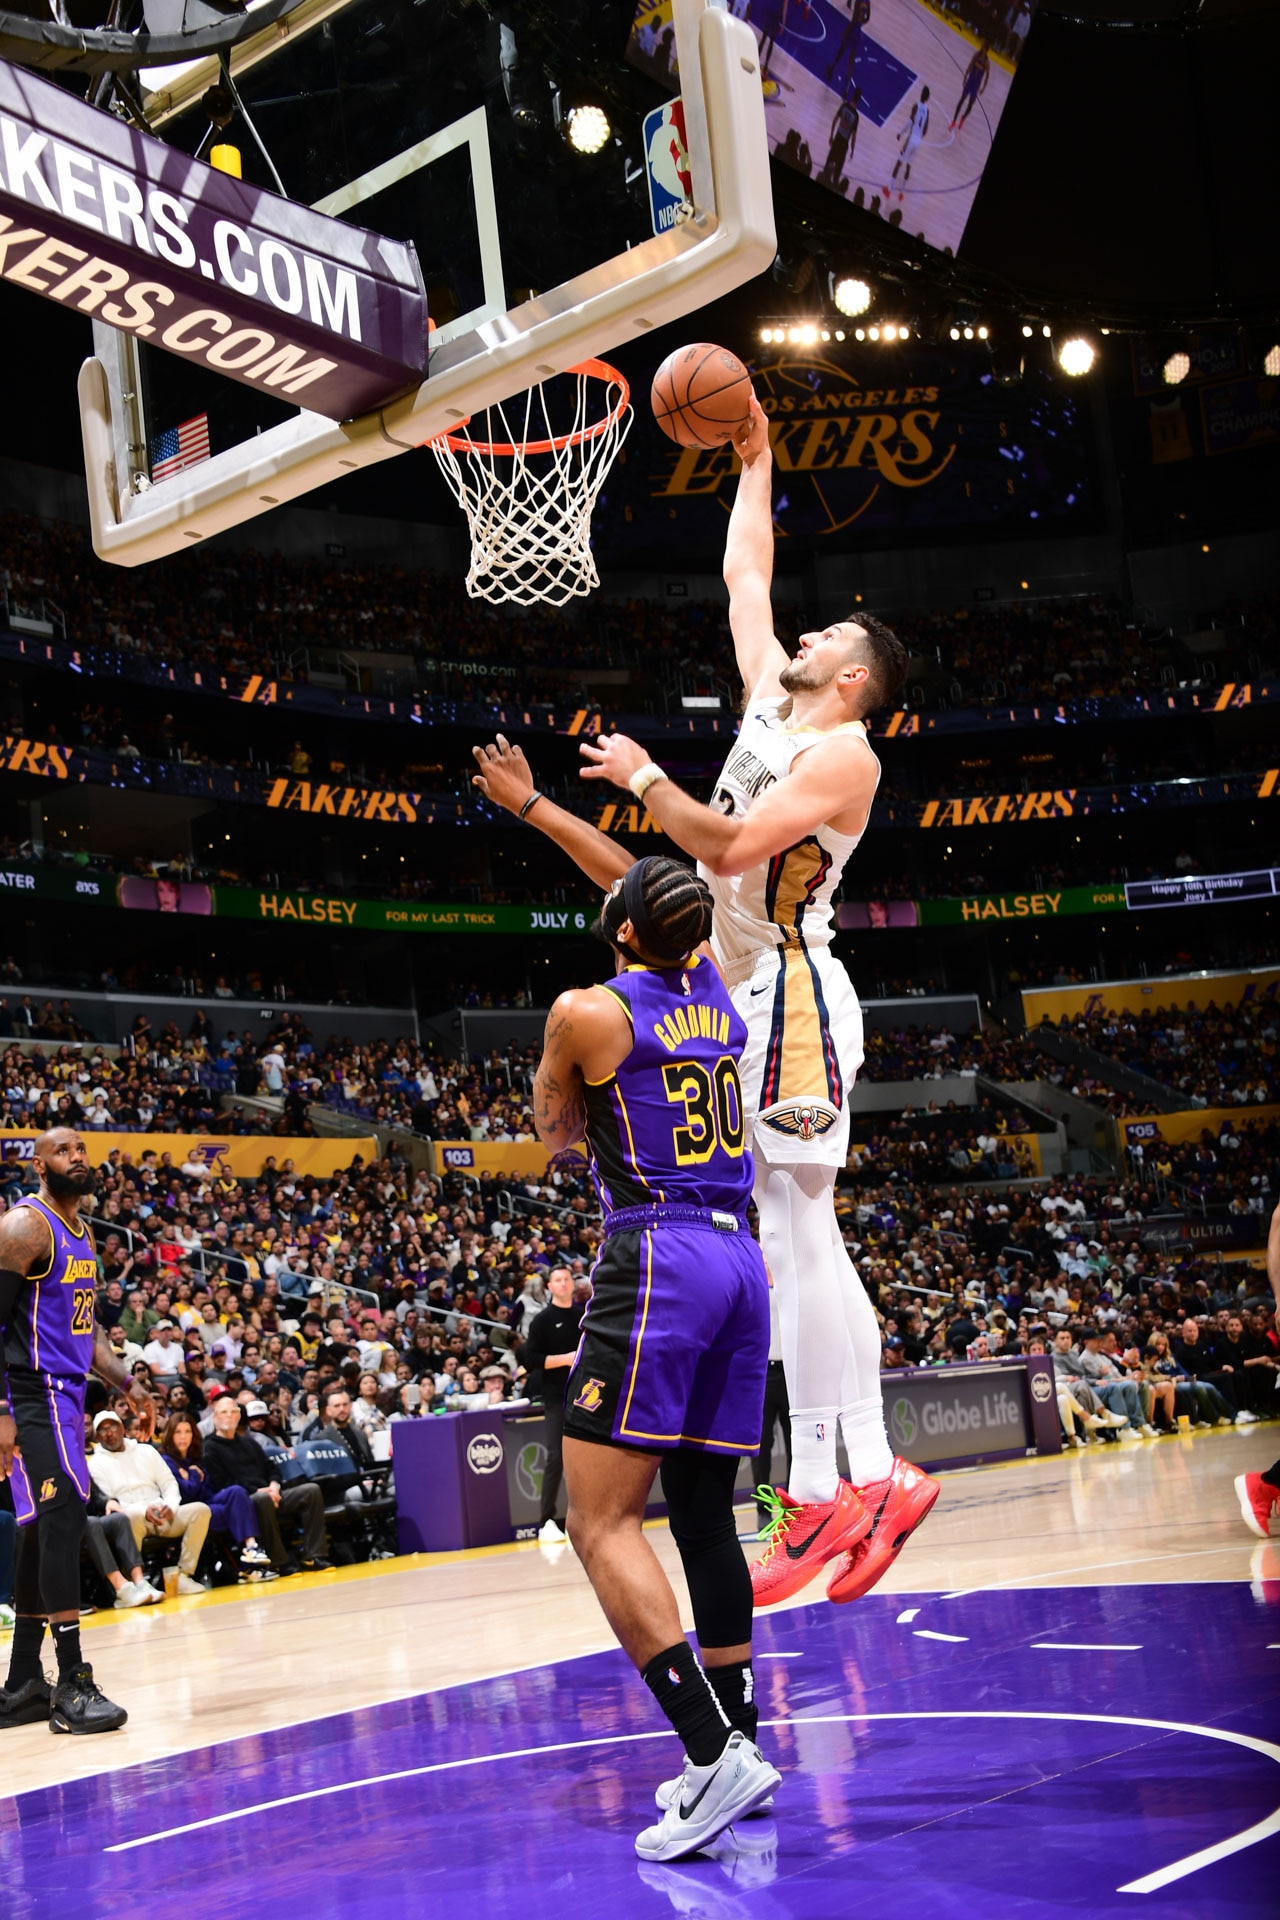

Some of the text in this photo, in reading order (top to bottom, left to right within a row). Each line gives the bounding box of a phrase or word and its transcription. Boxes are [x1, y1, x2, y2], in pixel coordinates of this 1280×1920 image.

[0, 116, 362, 342] KERS.COM
[763, 385, 940, 414] OS ANGELES
[75, 880, 100, 895] axs
[1151, 884, 1181, 896] Happy
[1205, 877, 1243, 890] Birthday
[259, 893, 357, 924] HALSEY
[961, 892, 1062, 921] HALSEY
[1093, 893, 1115, 905] FOR
[385, 911, 495, 925] FOR MY LAST TRICK
[530, 912, 585, 929] JULY 6
[654, 1004, 730, 1052] GOODWIN
[661, 1055, 745, 1166] 30
[445, 1150, 471, 1166] 103
[1190, 1223, 1234, 1239] ULTRA
[71, 1288, 95, 1336] 23
[922, 1391, 1019, 1435] Globe Life
[313, 1449, 348, 1460] DELTA
